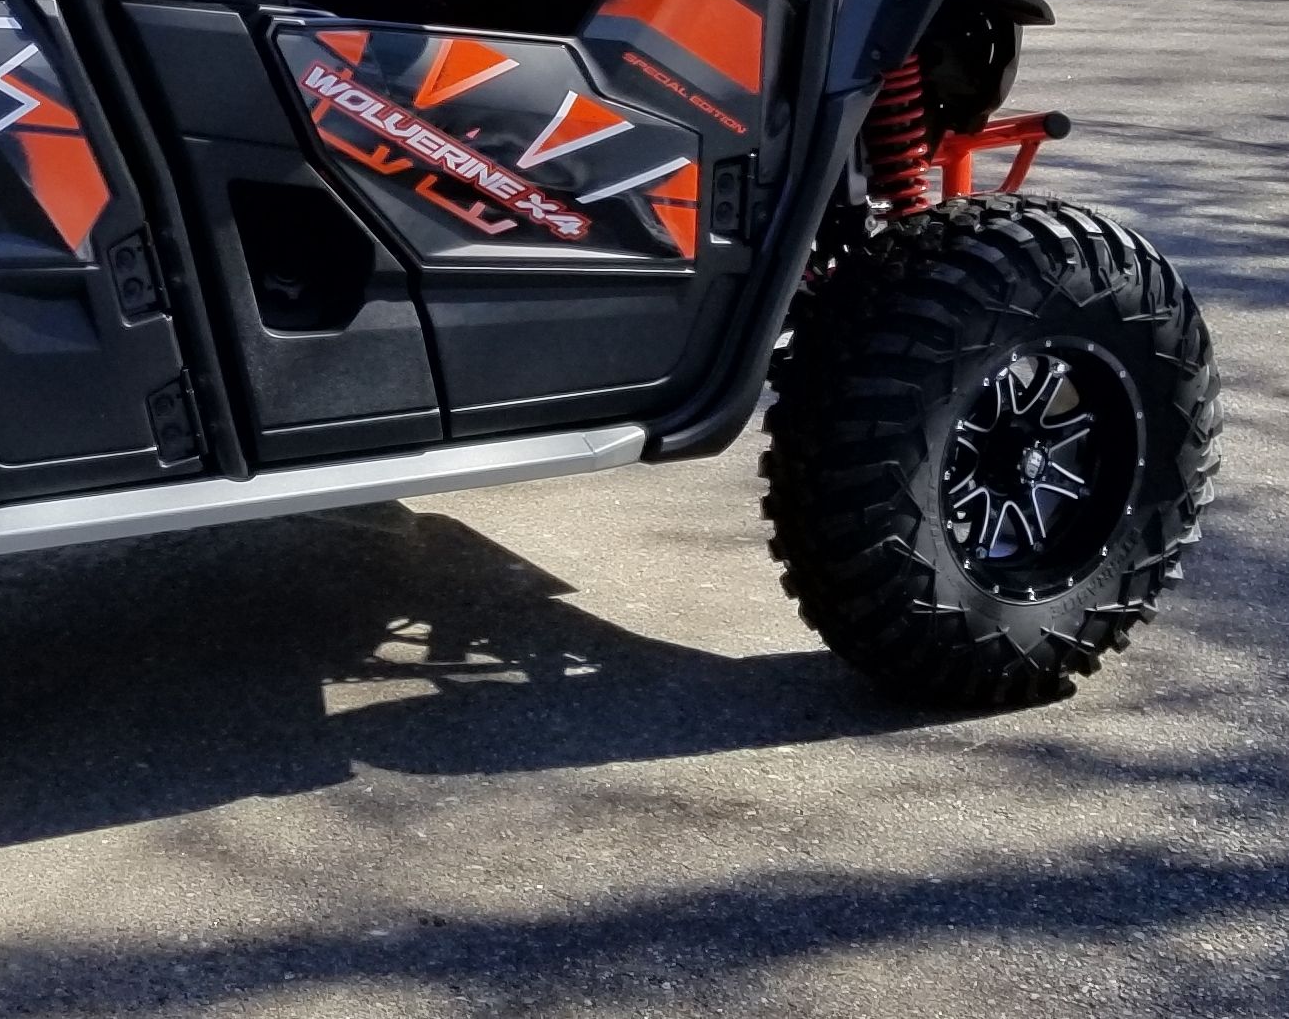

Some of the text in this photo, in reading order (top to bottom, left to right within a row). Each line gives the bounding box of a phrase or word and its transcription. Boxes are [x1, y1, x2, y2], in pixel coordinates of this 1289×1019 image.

[303, 64, 586, 237] WOLVERINE X4
[621, 51, 747, 134] SPECIAL EDITION
